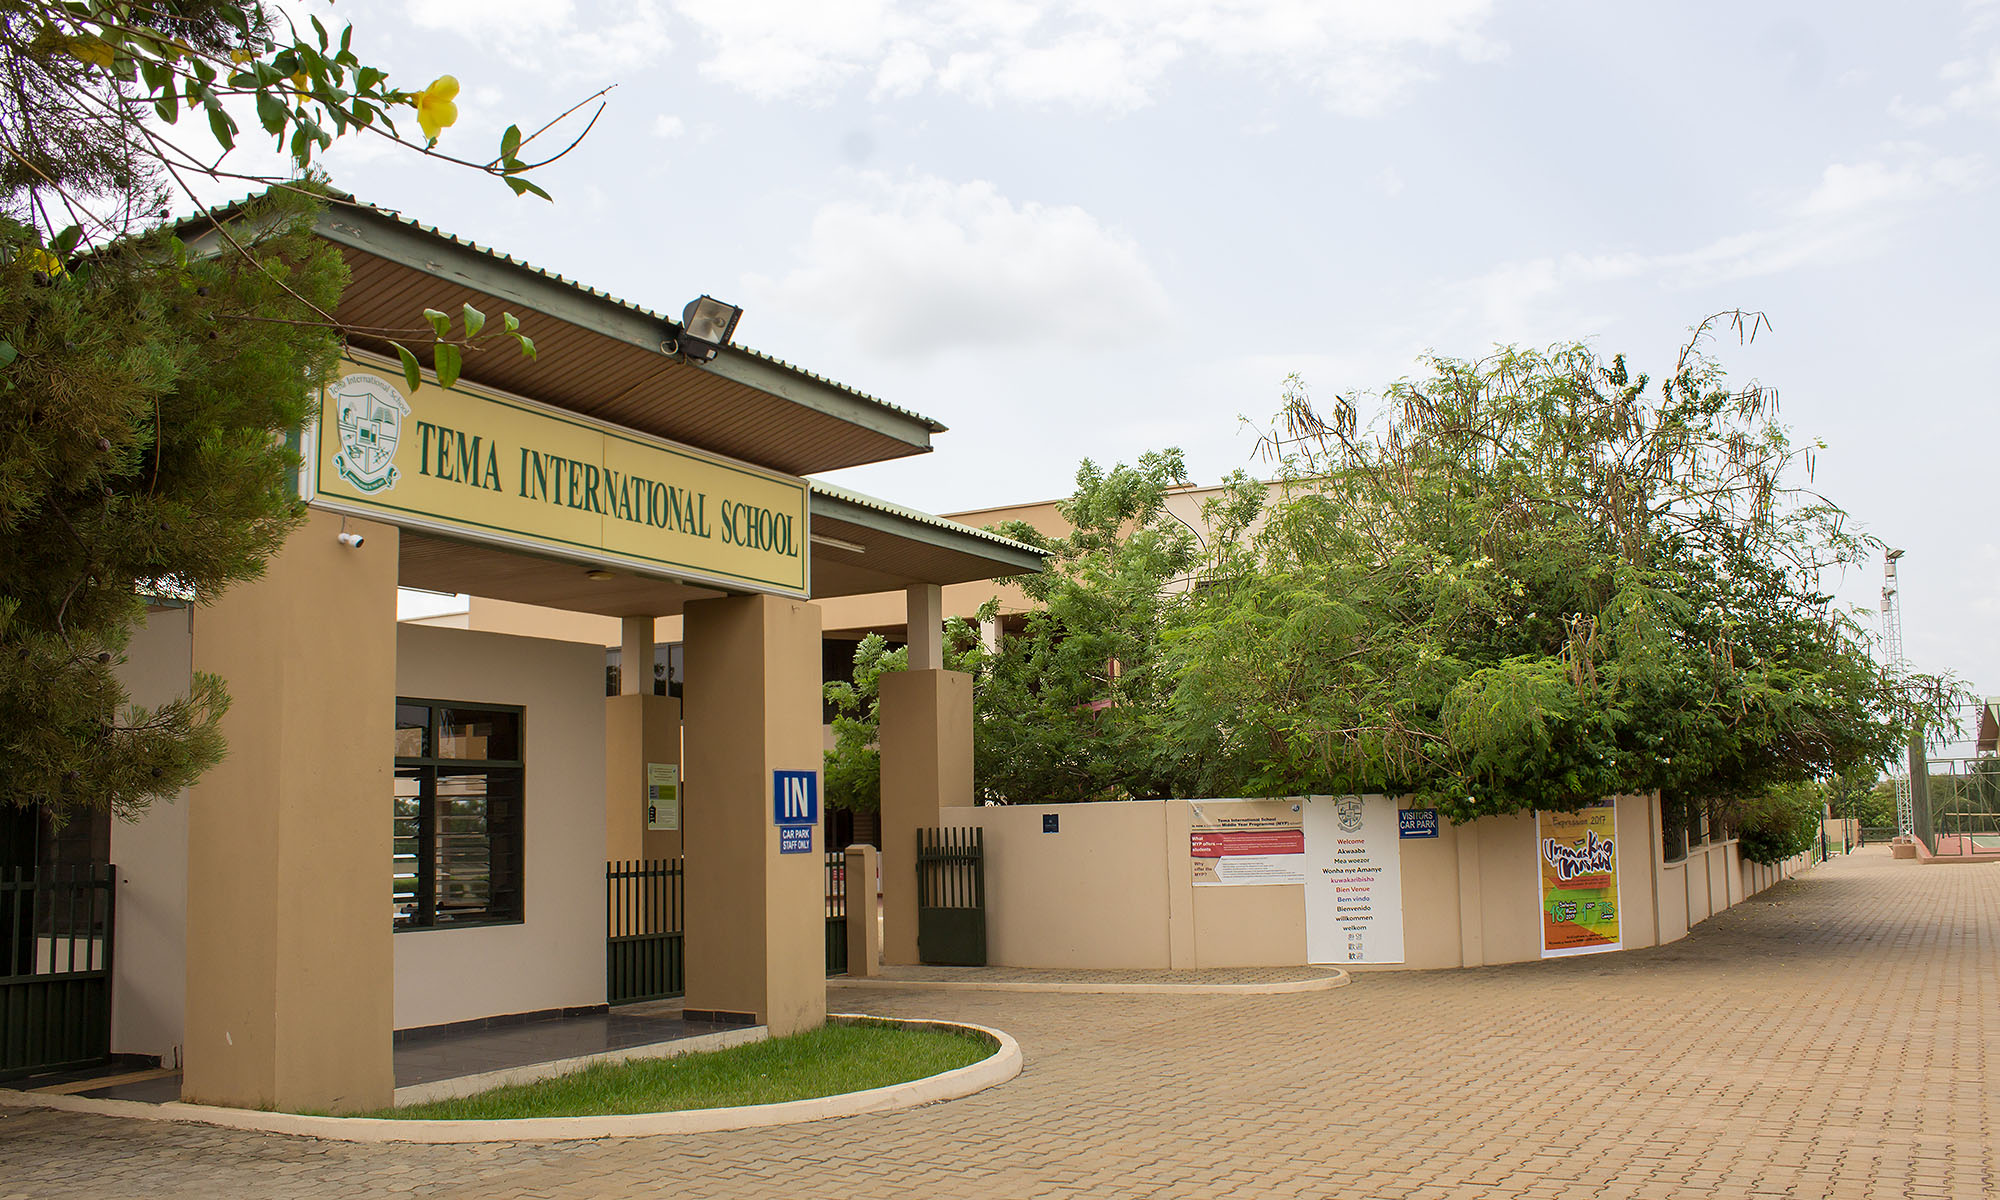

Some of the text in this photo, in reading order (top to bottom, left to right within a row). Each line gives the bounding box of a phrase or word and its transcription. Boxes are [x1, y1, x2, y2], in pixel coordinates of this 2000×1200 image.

[416, 420, 799, 558] TEMA INTERNATIONAL SCHOOL
[784, 777, 808, 817] IN
[1402, 811, 1433, 820] VISITORS
[1590, 815, 1606, 825] 2017
[1400, 820, 1436, 829] CAR PARK
[783, 829, 810, 839] CAR PARK
[783, 840, 810, 850] STAFF ONLY
[1550, 904, 1565, 923] 18
